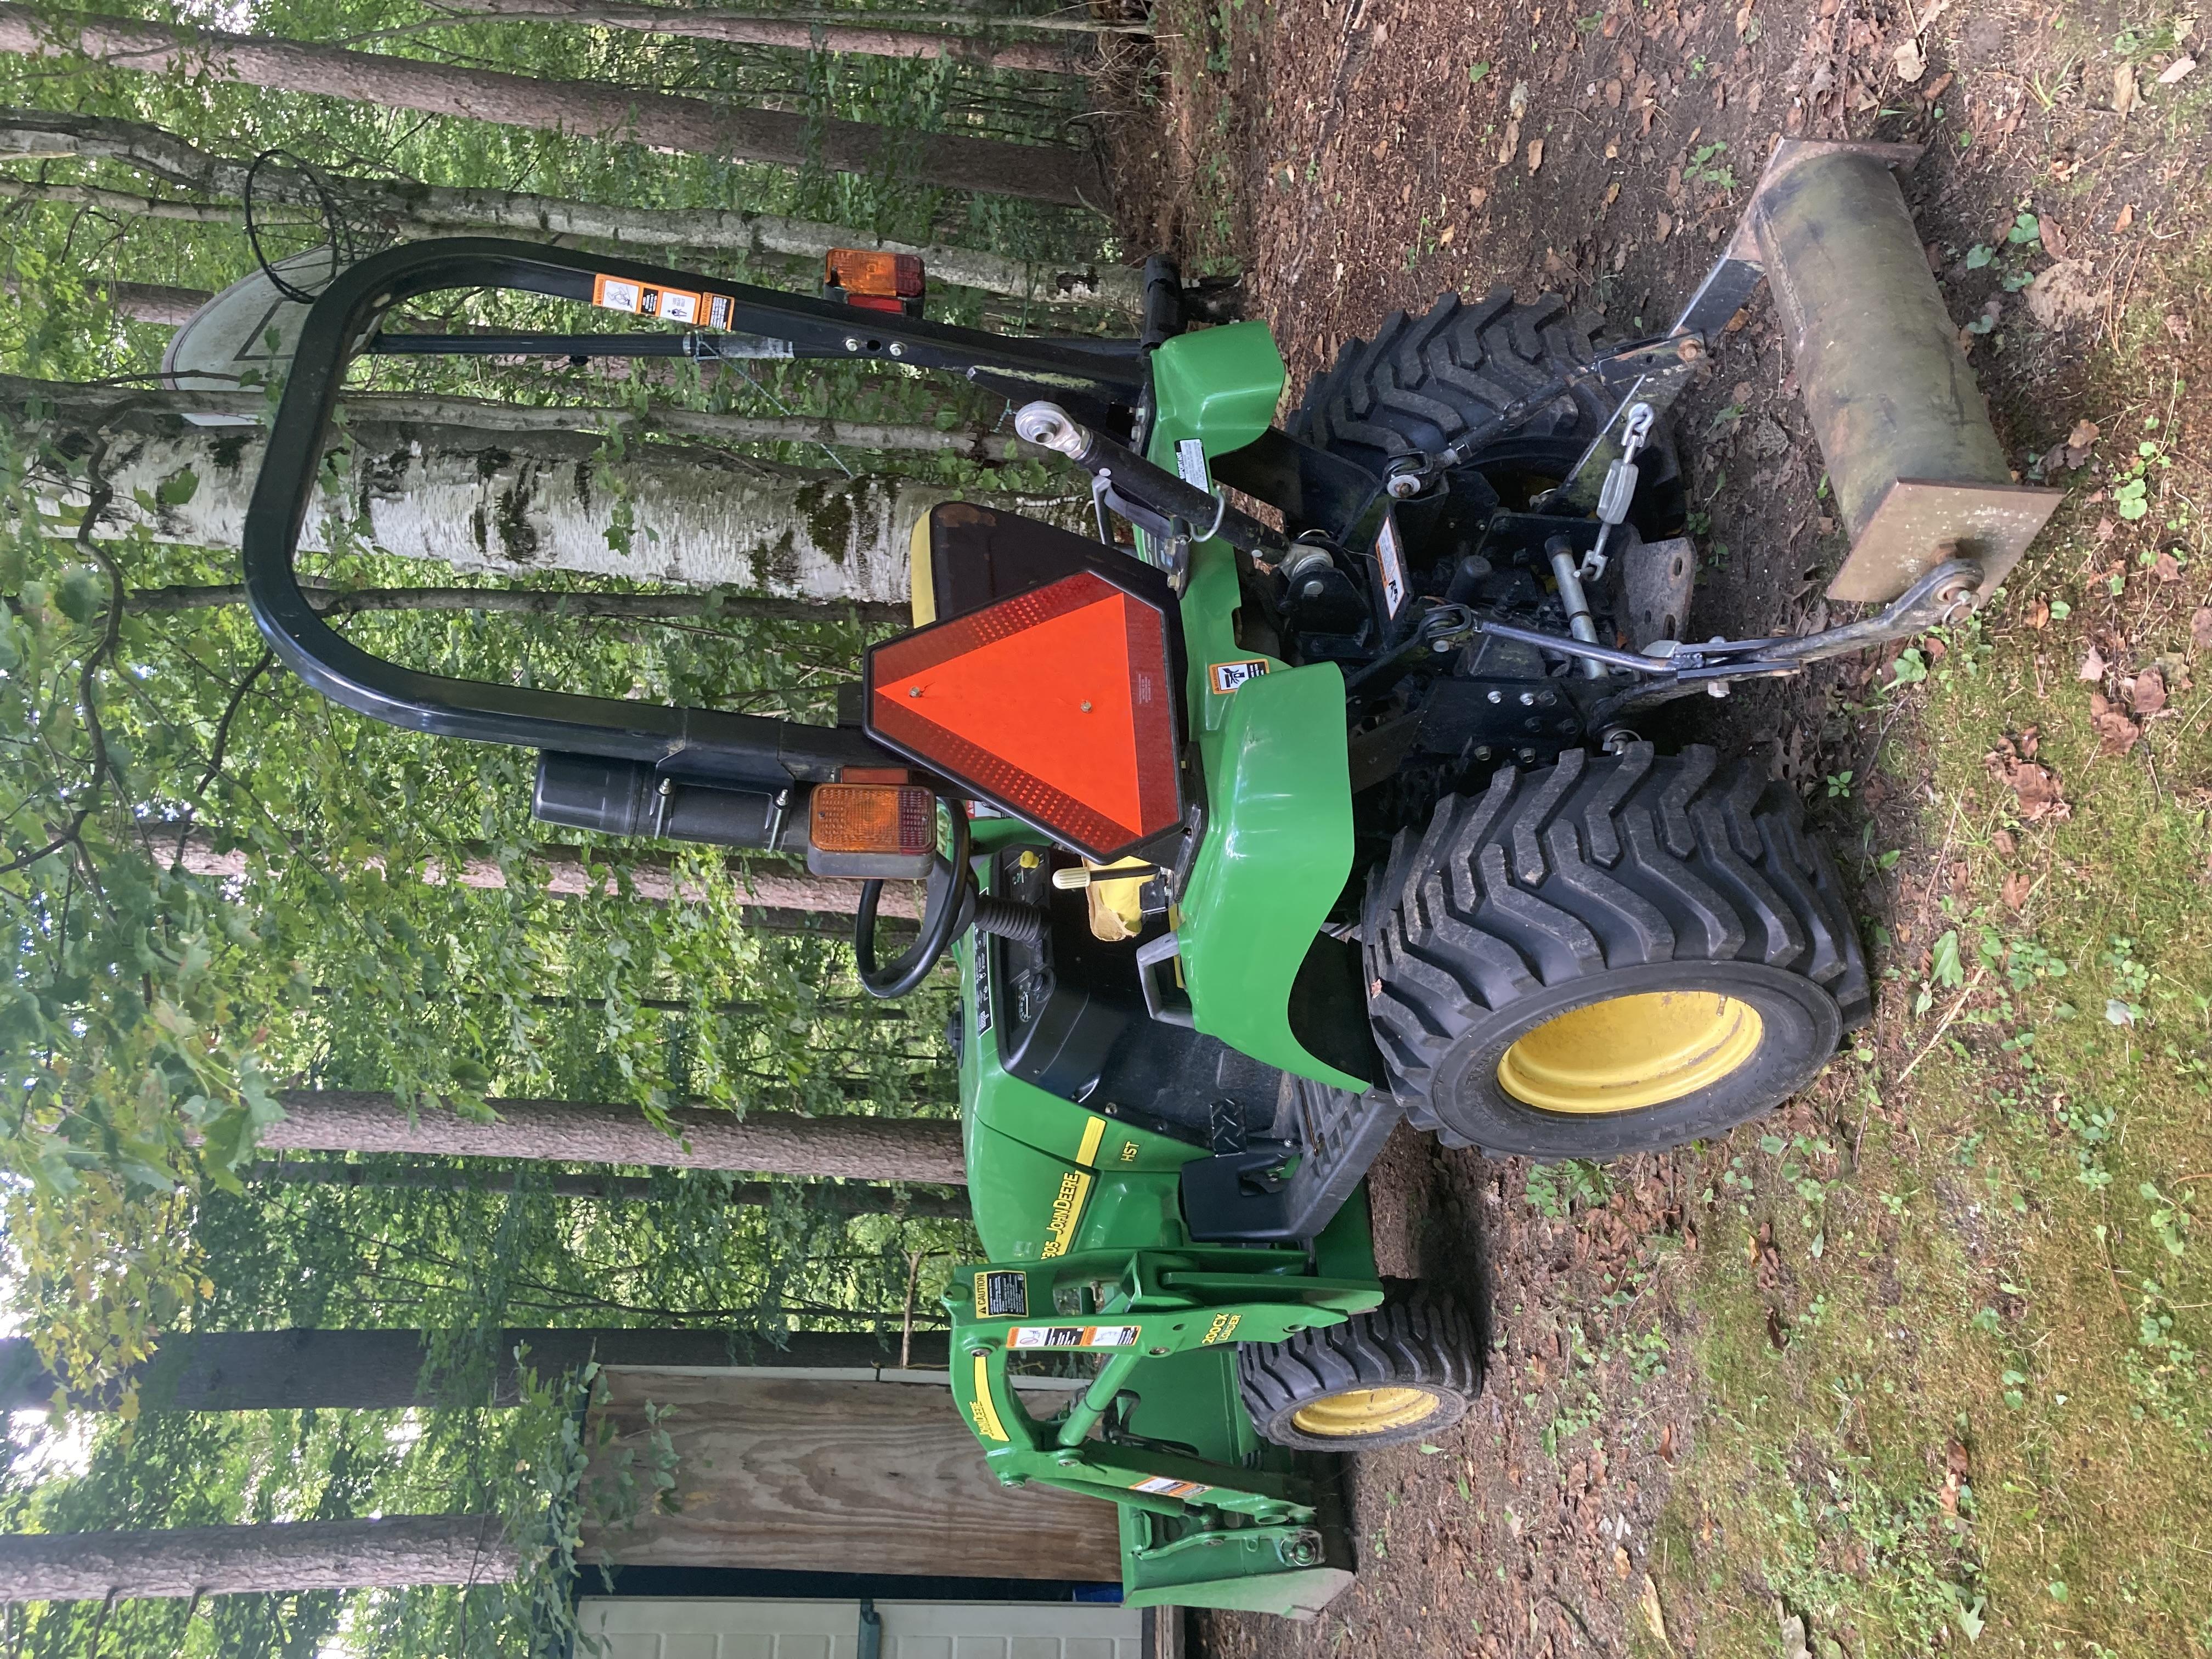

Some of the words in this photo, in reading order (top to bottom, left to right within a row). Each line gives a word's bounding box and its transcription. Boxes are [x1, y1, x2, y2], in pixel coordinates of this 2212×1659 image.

[702, 294, 711, 323] WARNING
[1176, 452, 1186, 479] IMPORTANT
[1120, 1141, 1140, 1162] HST
[1040, 1241, 1060, 1260] 305
[977, 1274, 986, 1305] CAUTION
[1201, 1313, 1230, 1344] 200CX
[1218, 1314, 1243, 1340] LOADER
